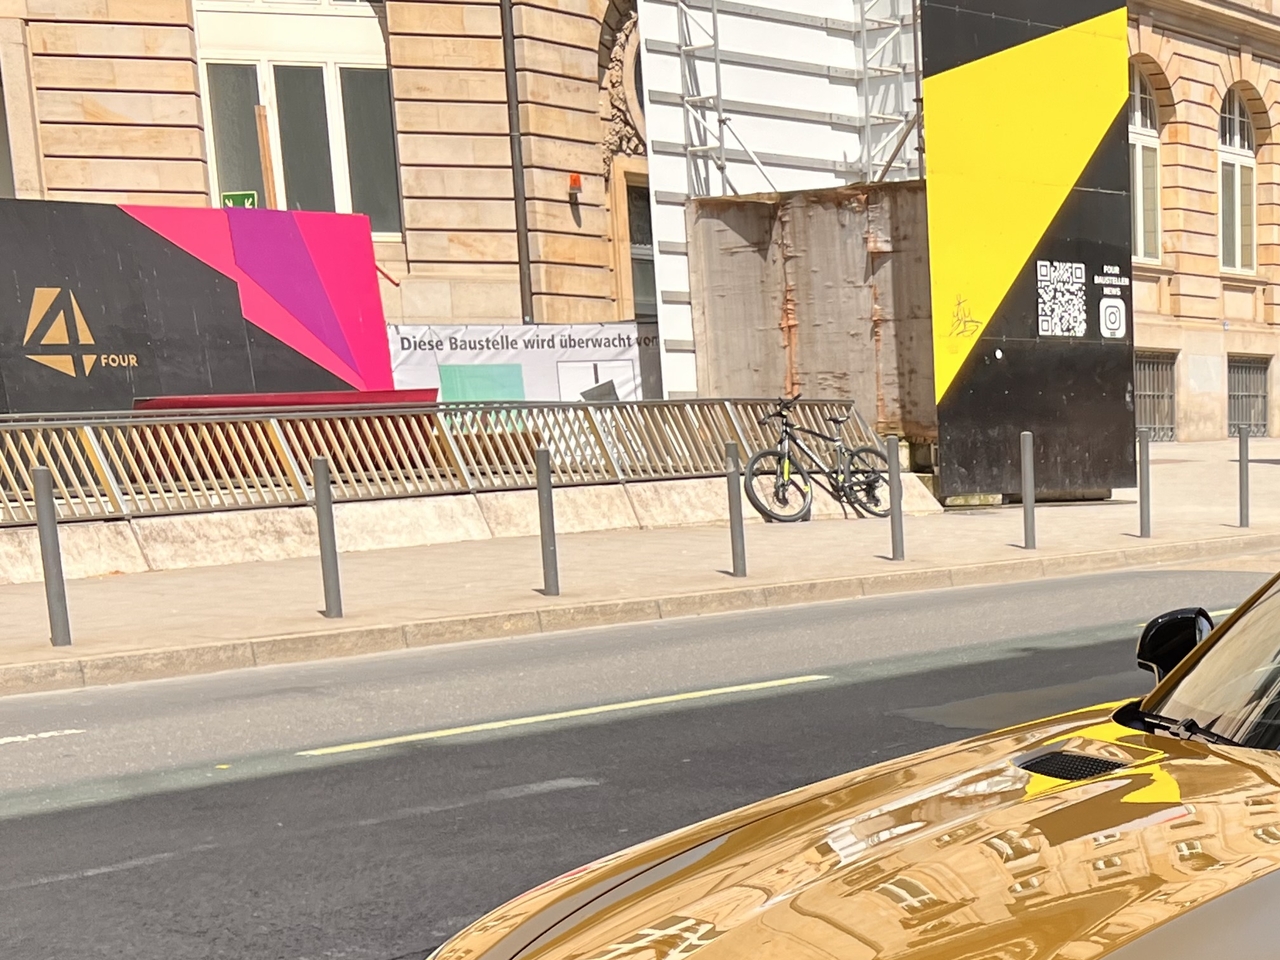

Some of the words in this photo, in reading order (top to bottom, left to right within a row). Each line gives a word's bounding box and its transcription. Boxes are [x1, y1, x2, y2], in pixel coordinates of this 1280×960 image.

[1103, 265, 1120, 274] FOUR
[1103, 286, 1121, 296] NEWS
[400, 336, 444, 351] Diese
[449, 335, 518, 350] Baustelle
[523, 334, 556, 349] wird
[560, 333, 632, 349] überwacht
[101, 354, 139, 367] FOUR
